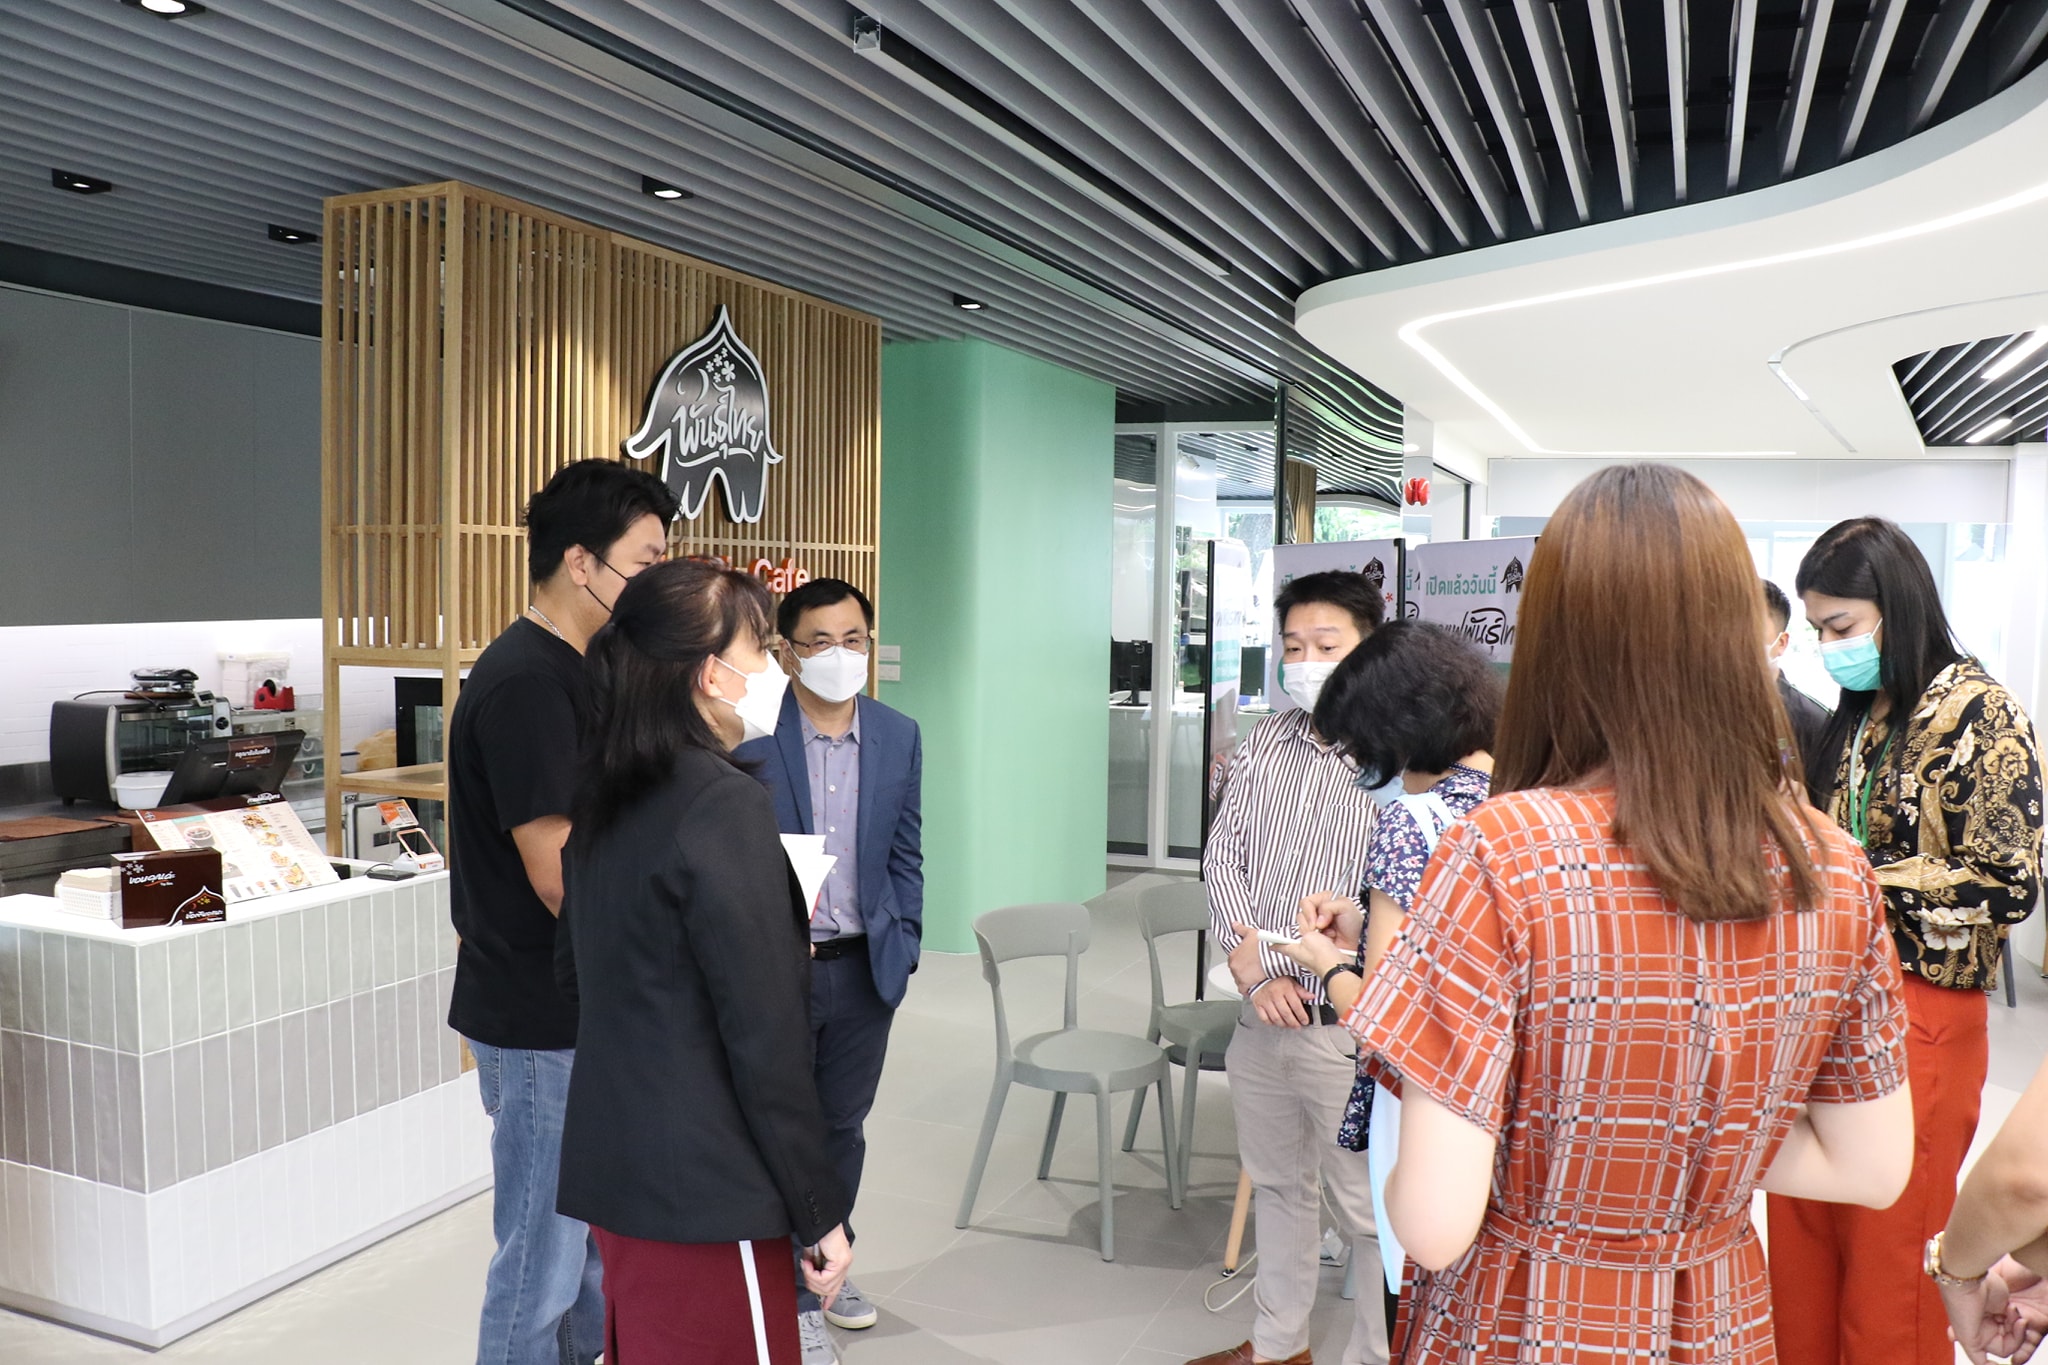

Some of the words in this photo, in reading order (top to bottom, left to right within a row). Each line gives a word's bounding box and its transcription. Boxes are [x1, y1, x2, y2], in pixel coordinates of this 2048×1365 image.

[671, 384, 764, 460] พันธุ์ไทย
[750, 558, 810, 593] Cafe
[1425, 565, 1498, 596] เปิดแล้ววันนี้
